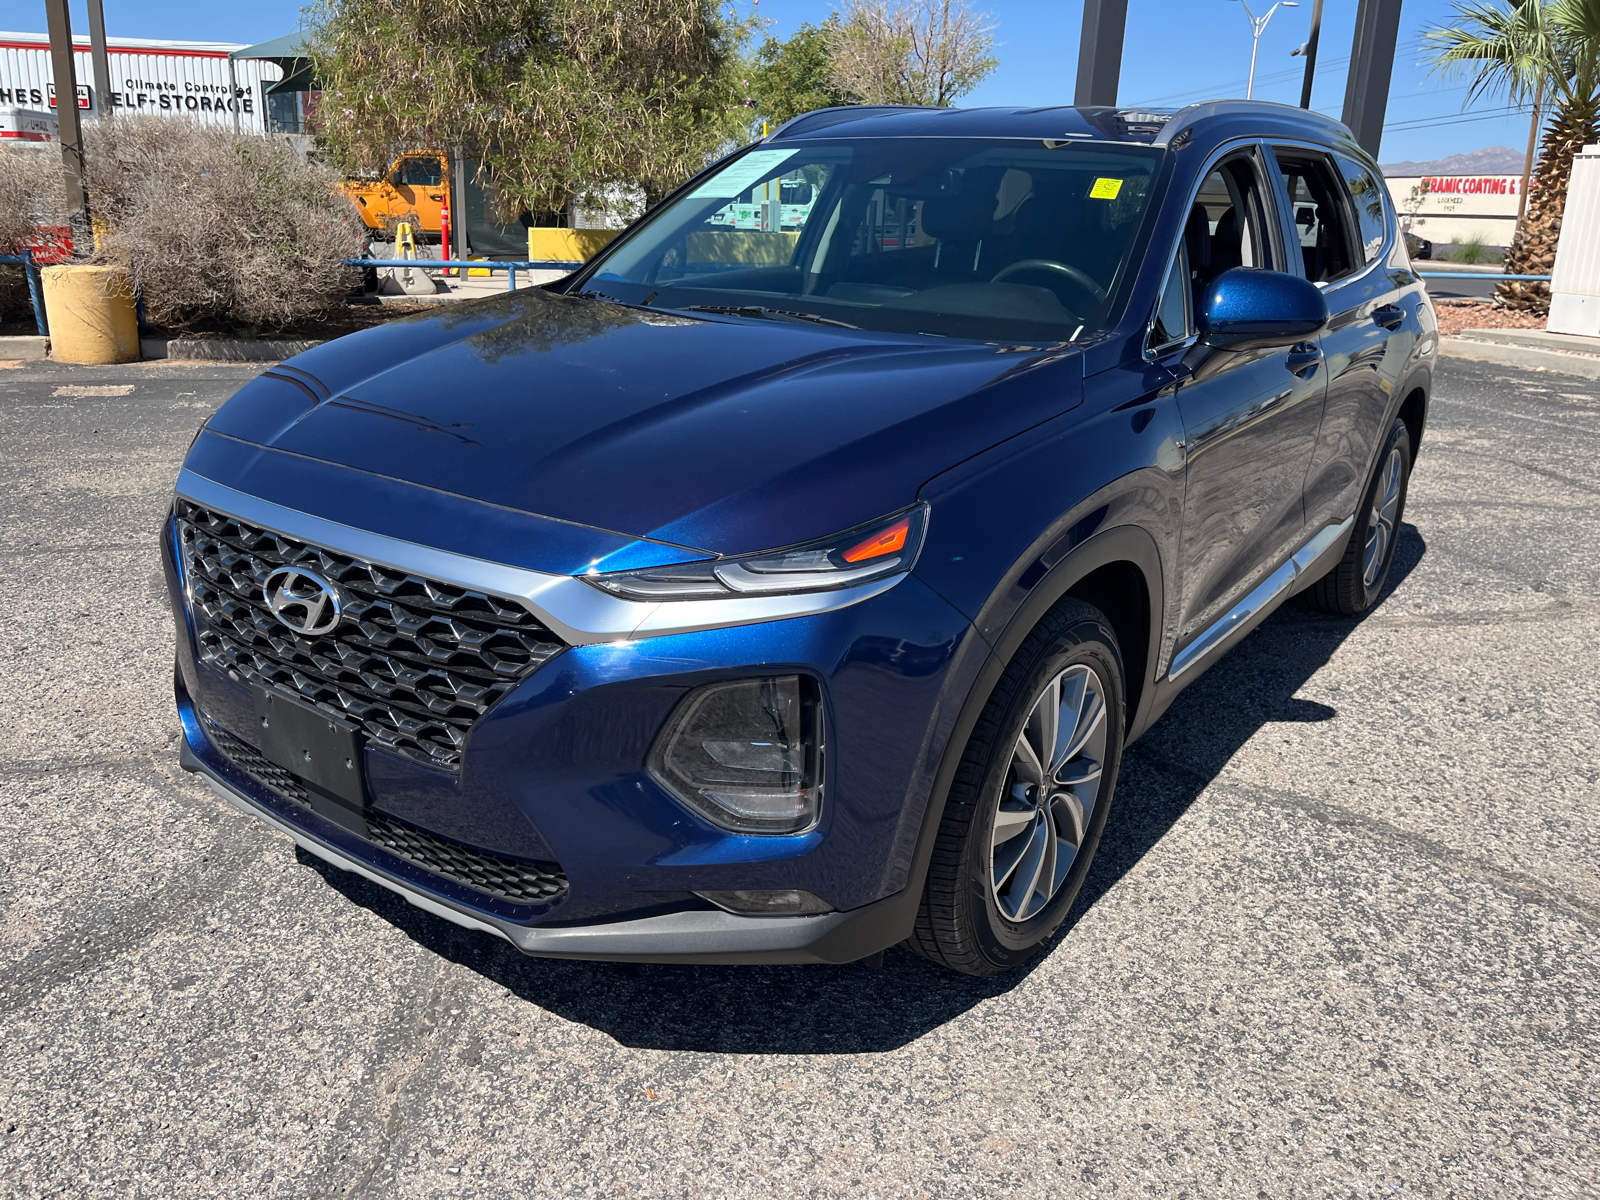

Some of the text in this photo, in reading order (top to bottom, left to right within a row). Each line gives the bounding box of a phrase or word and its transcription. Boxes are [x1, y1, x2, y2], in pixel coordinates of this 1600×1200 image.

[126, 79, 252, 97] Climate Controled
[110, 93, 254, 113] ELF-STORAGE
[1463, 178, 1507, 195] COATING
